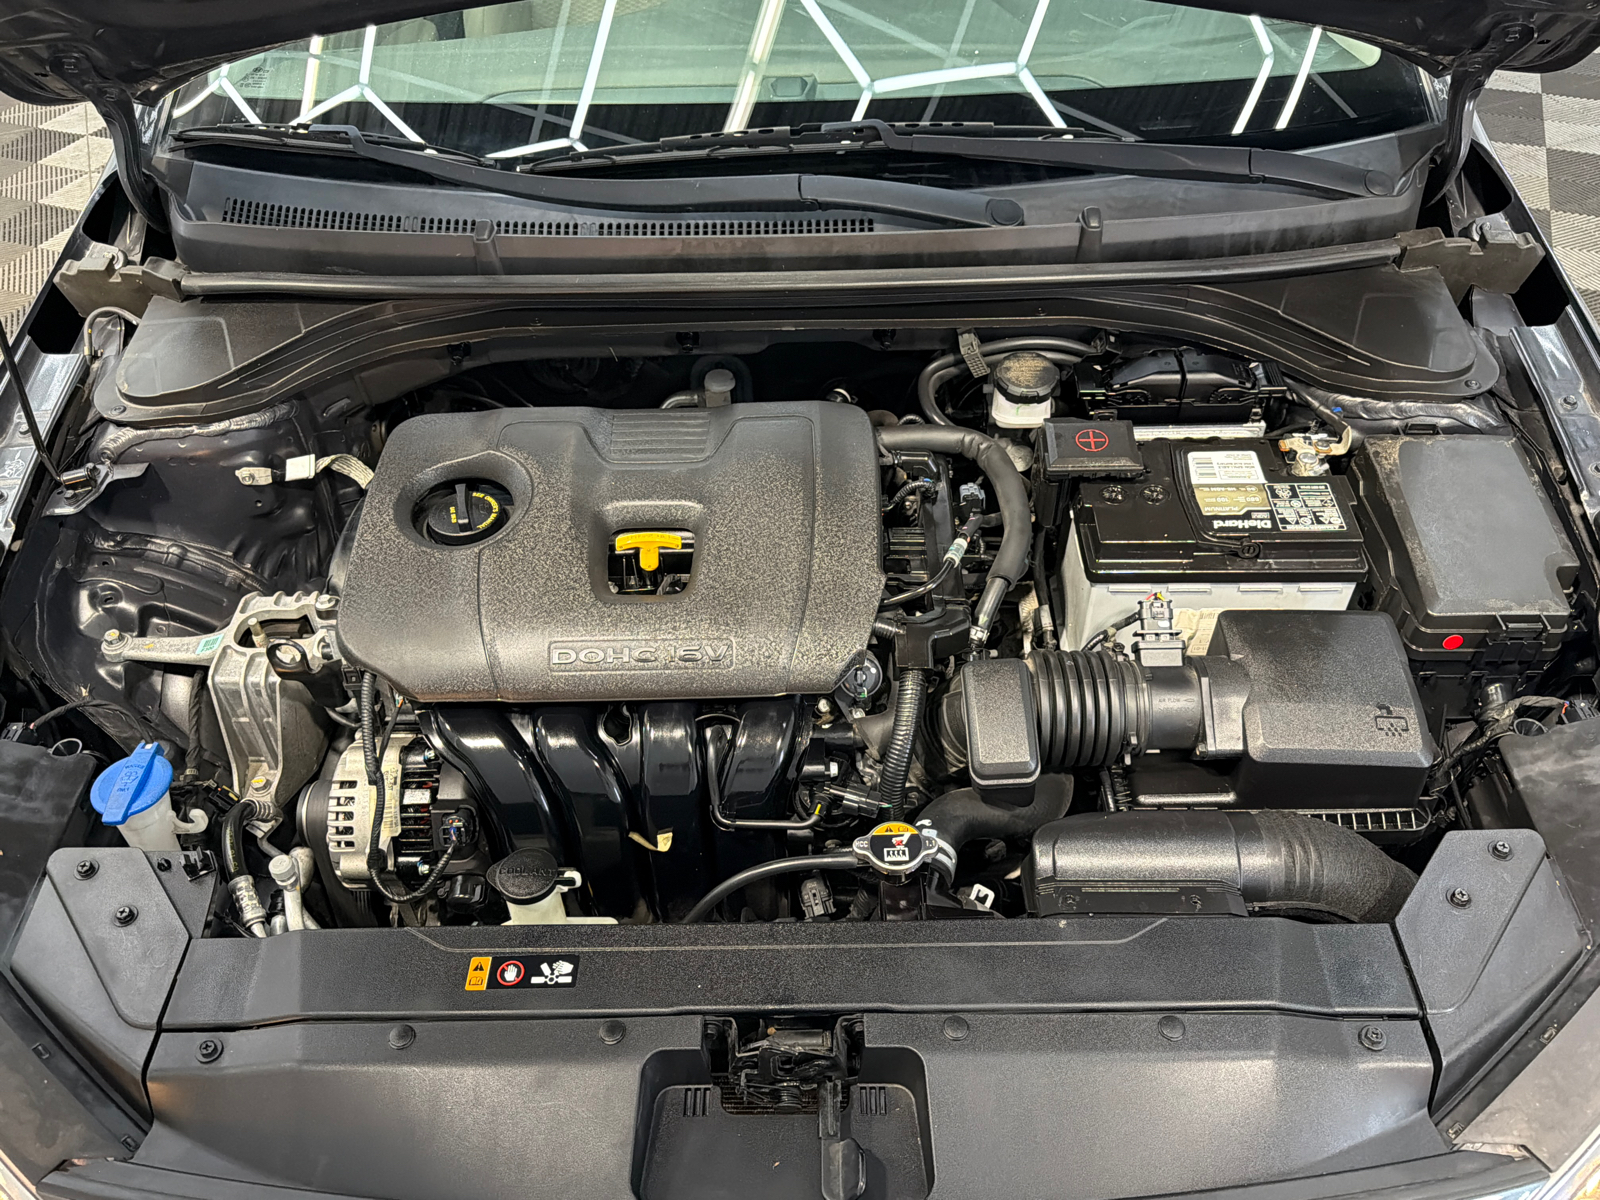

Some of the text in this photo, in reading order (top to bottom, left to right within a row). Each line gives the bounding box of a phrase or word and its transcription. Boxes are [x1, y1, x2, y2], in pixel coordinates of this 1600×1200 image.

[1213, 519, 1272, 529] DieHard
[552, 645, 730, 664] DOHC 16V
[499, 866, 554, 876] COOLANT
